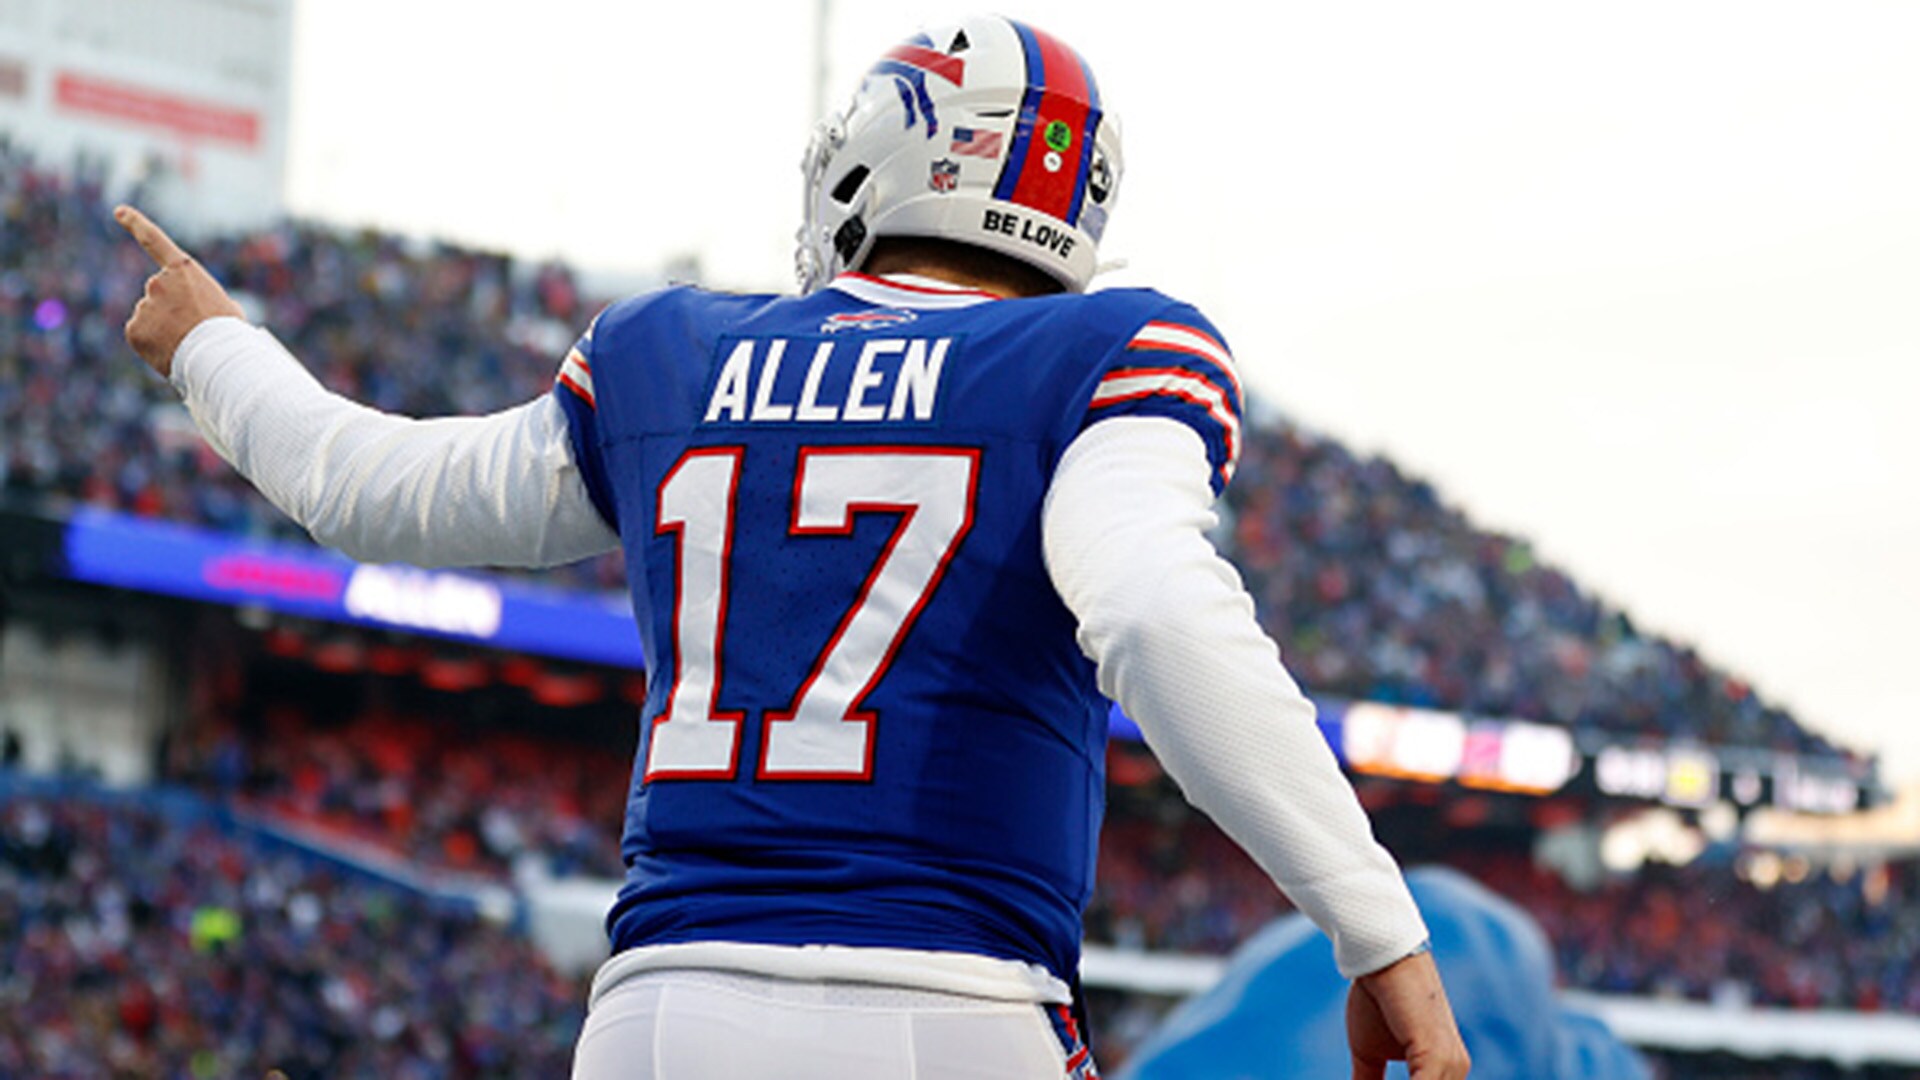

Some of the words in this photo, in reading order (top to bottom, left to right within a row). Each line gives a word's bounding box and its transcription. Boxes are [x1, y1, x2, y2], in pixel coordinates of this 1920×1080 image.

[983, 209, 1018, 236] BE
[1021, 219, 1076, 259] LOVE
[704, 338, 951, 422] ALLEN
[643, 445, 982, 783] 17
